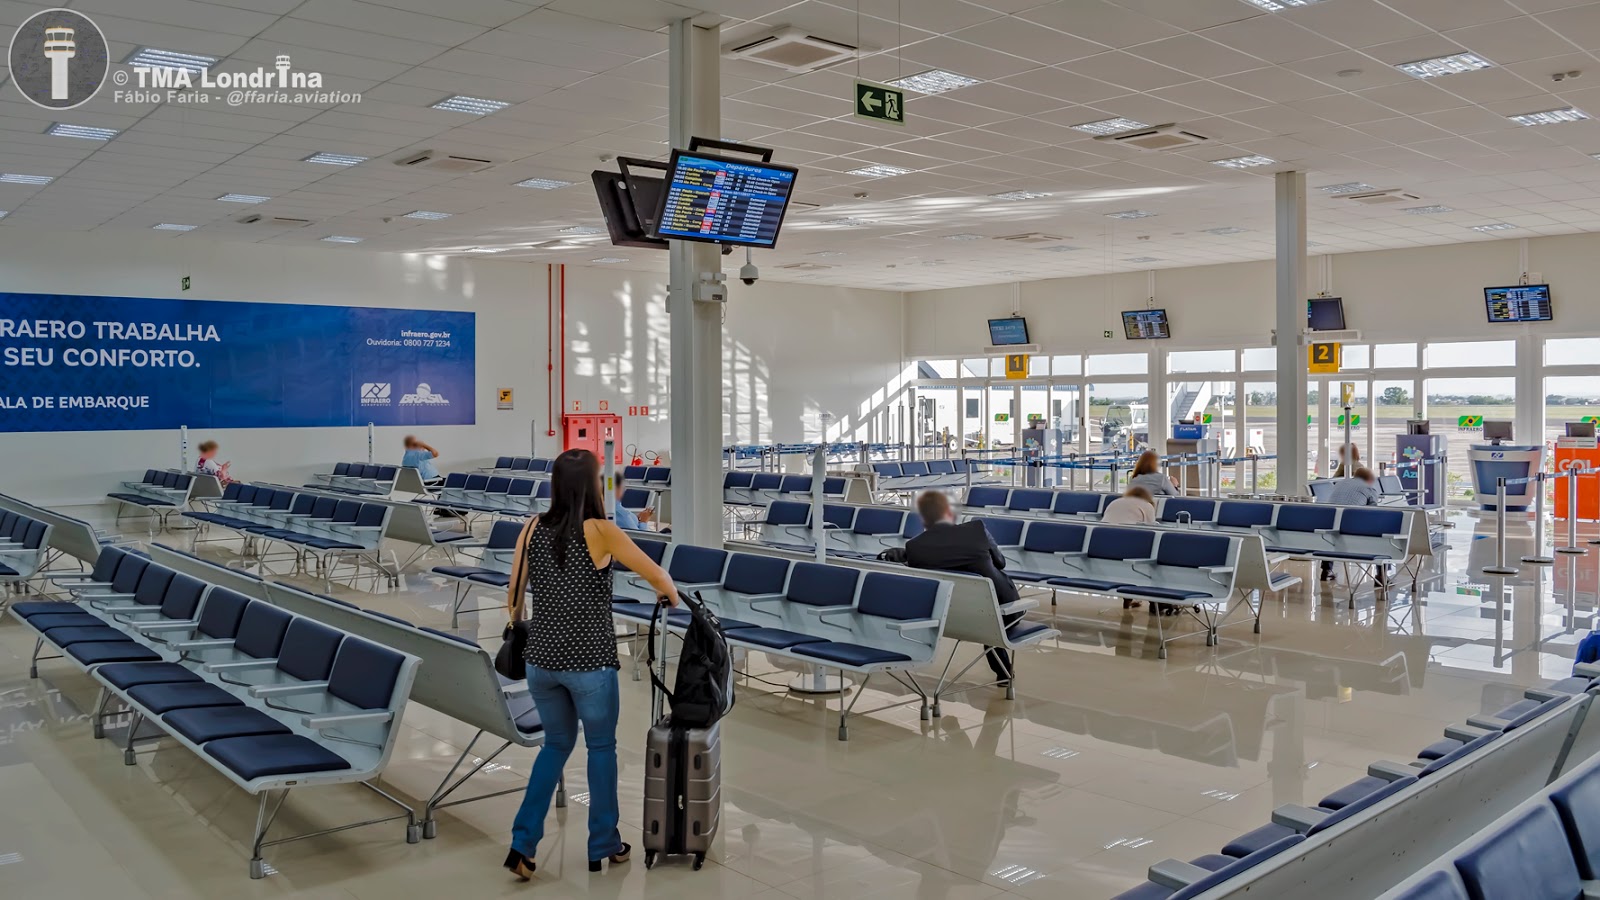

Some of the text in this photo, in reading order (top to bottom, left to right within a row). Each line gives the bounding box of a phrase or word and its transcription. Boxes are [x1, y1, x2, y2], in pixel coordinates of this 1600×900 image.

[726, 163, 762, 173] Departures
[0, 318, 220, 342] RAERO TRABALHA
[401, 330, 450, 339] infraero.gov.br
[366, 338, 402, 346] Ouvidoria:
[403, 339, 422, 347] 0800
[4, 347, 200, 368] SEU CONFORTO.
[1318, 345, 1329, 360] 2
[1013, 356, 1020, 369] 1
[32, 396, 54, 409] DE
[59, 396, 149, 410] EMBARQUE
[1558, 458, 1595, 474] GOL
